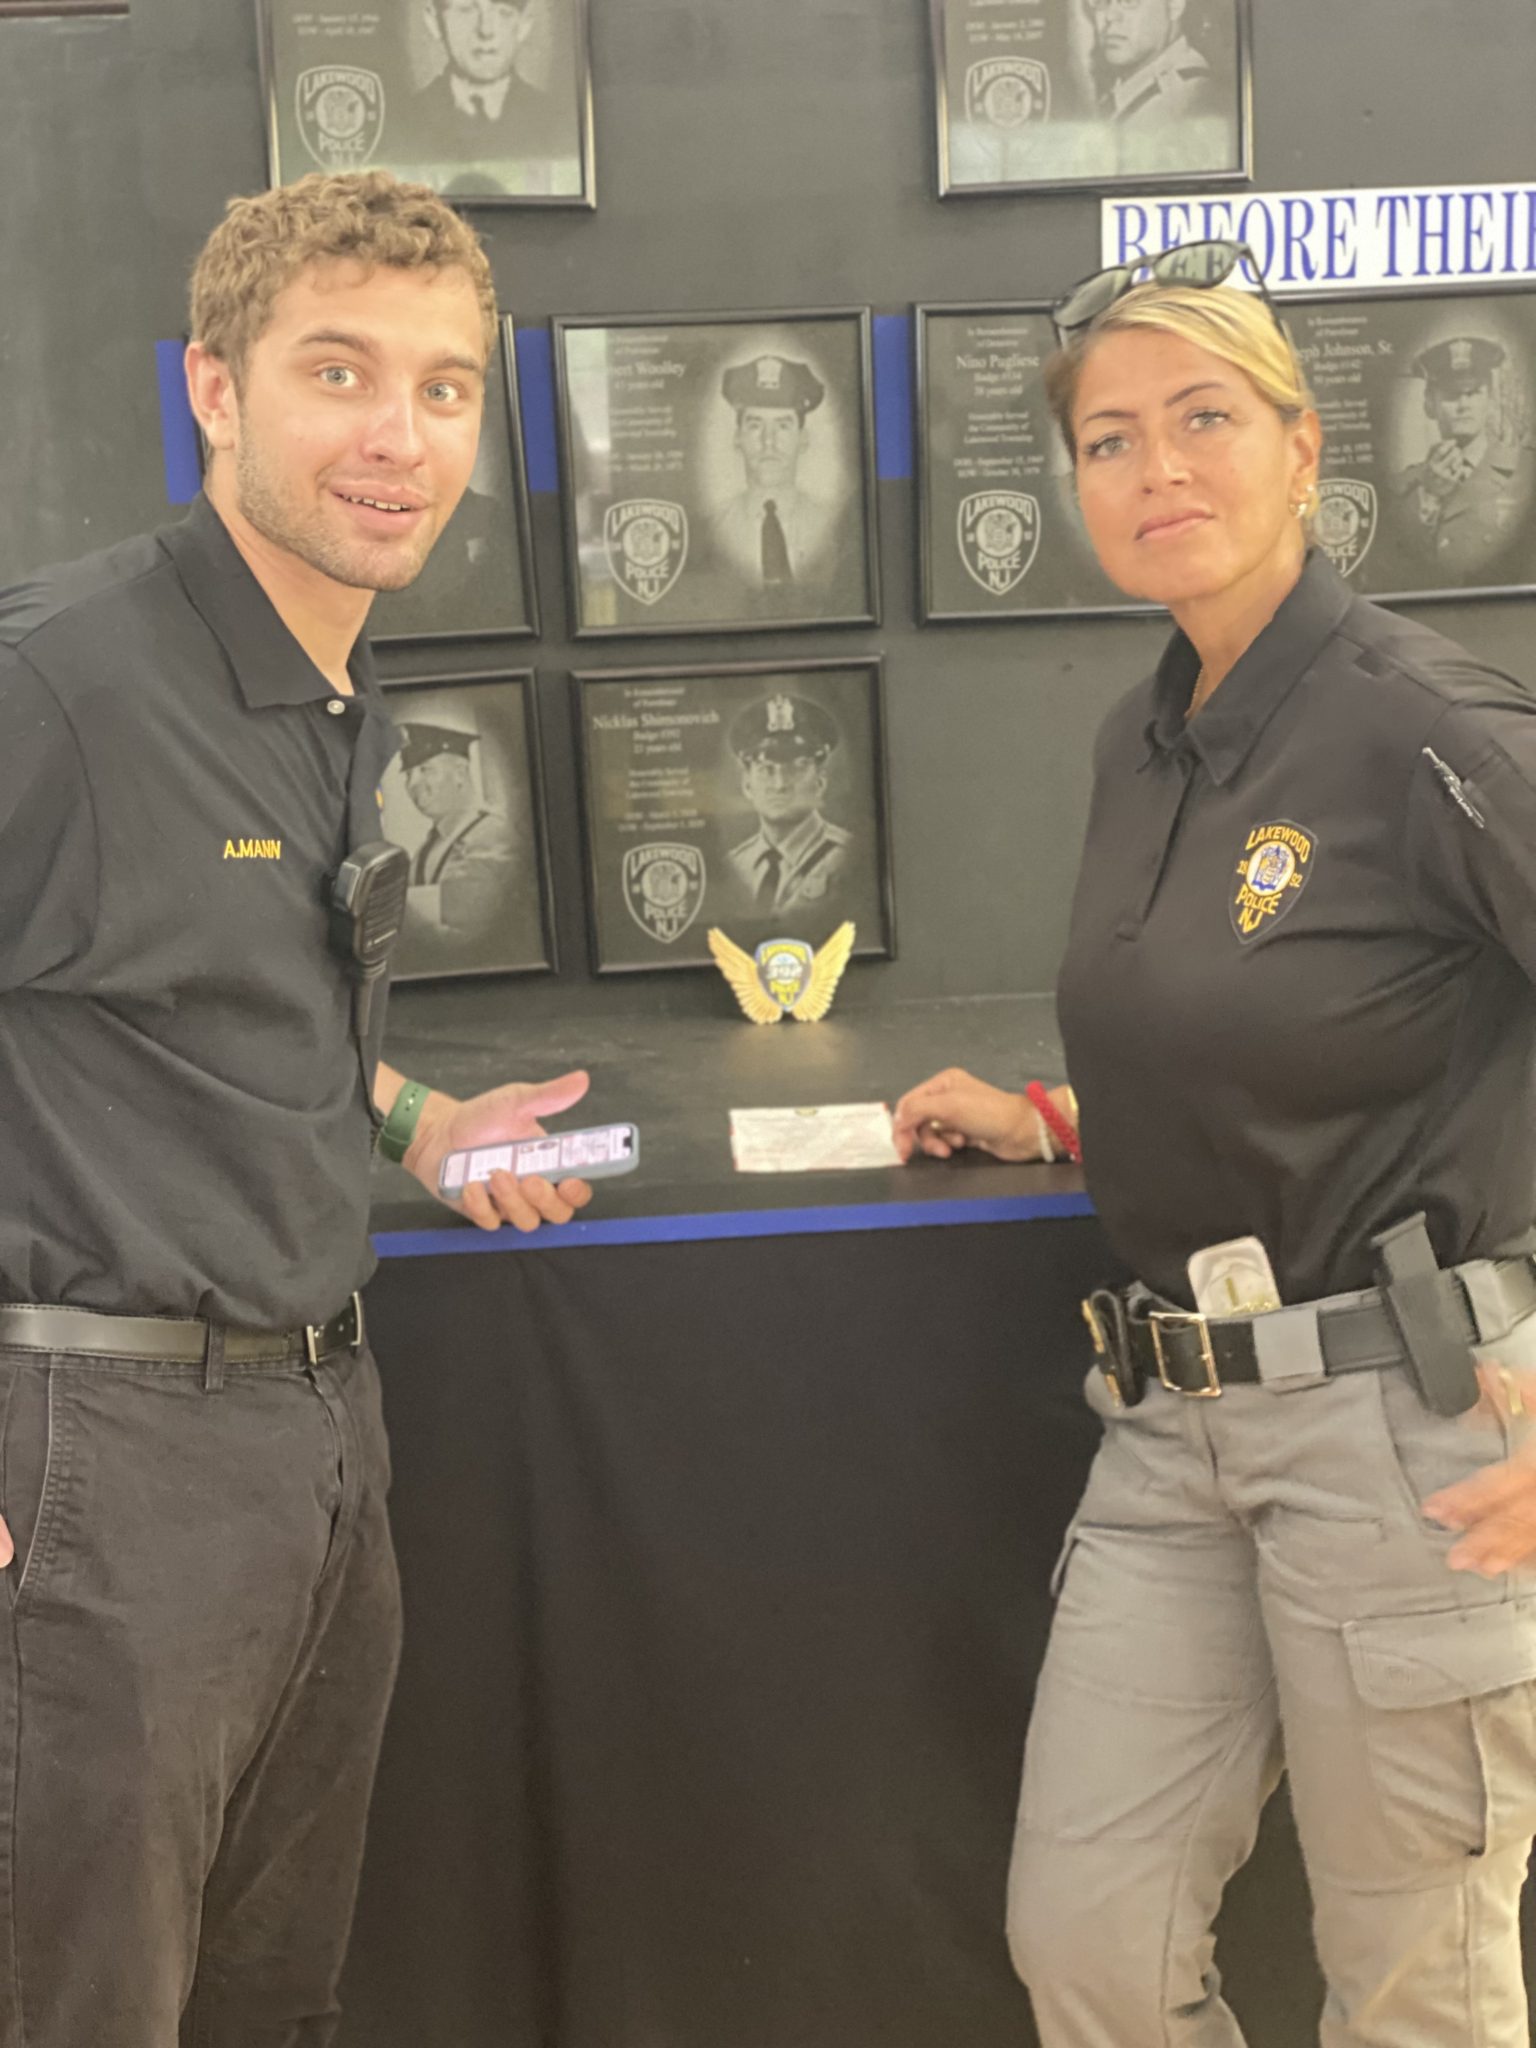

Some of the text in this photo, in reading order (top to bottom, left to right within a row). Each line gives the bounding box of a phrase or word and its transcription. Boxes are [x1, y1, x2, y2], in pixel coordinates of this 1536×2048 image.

[304, 71, 376, 104] LAKEWOOD
[973, 62, 1042, 98] LAKEWOOD
[318, 130, 365, 152] POLICE
[1113, 198, 1357, 284] BEFORE
[956, 355, 987, 369] Nino
[1318, 482, 1370, 513] KEWOOD
[611, 505, 680, 537] LAKEWOOD
[965, 495, 1033, 528] LAKEWOOD
[625, 558, 669, 580] POLICE
[977, 550, 1021, 571] POLICE
[637, 579, 660, 598] NJ
[989, 569, 1010, 588] NJ
[223, 838, 281, 859] A.MANN
[1245, 826, 1311, 863] LAKEWOOD
[630, 849, 698, 879] LAKEWOOD
[644, 900, 688, 920] POLICE
[1235, 883, 1282, 914] POLICE
[656, 918, 678, 938] NJ
[1238, 907, 1263, 934] NJ
